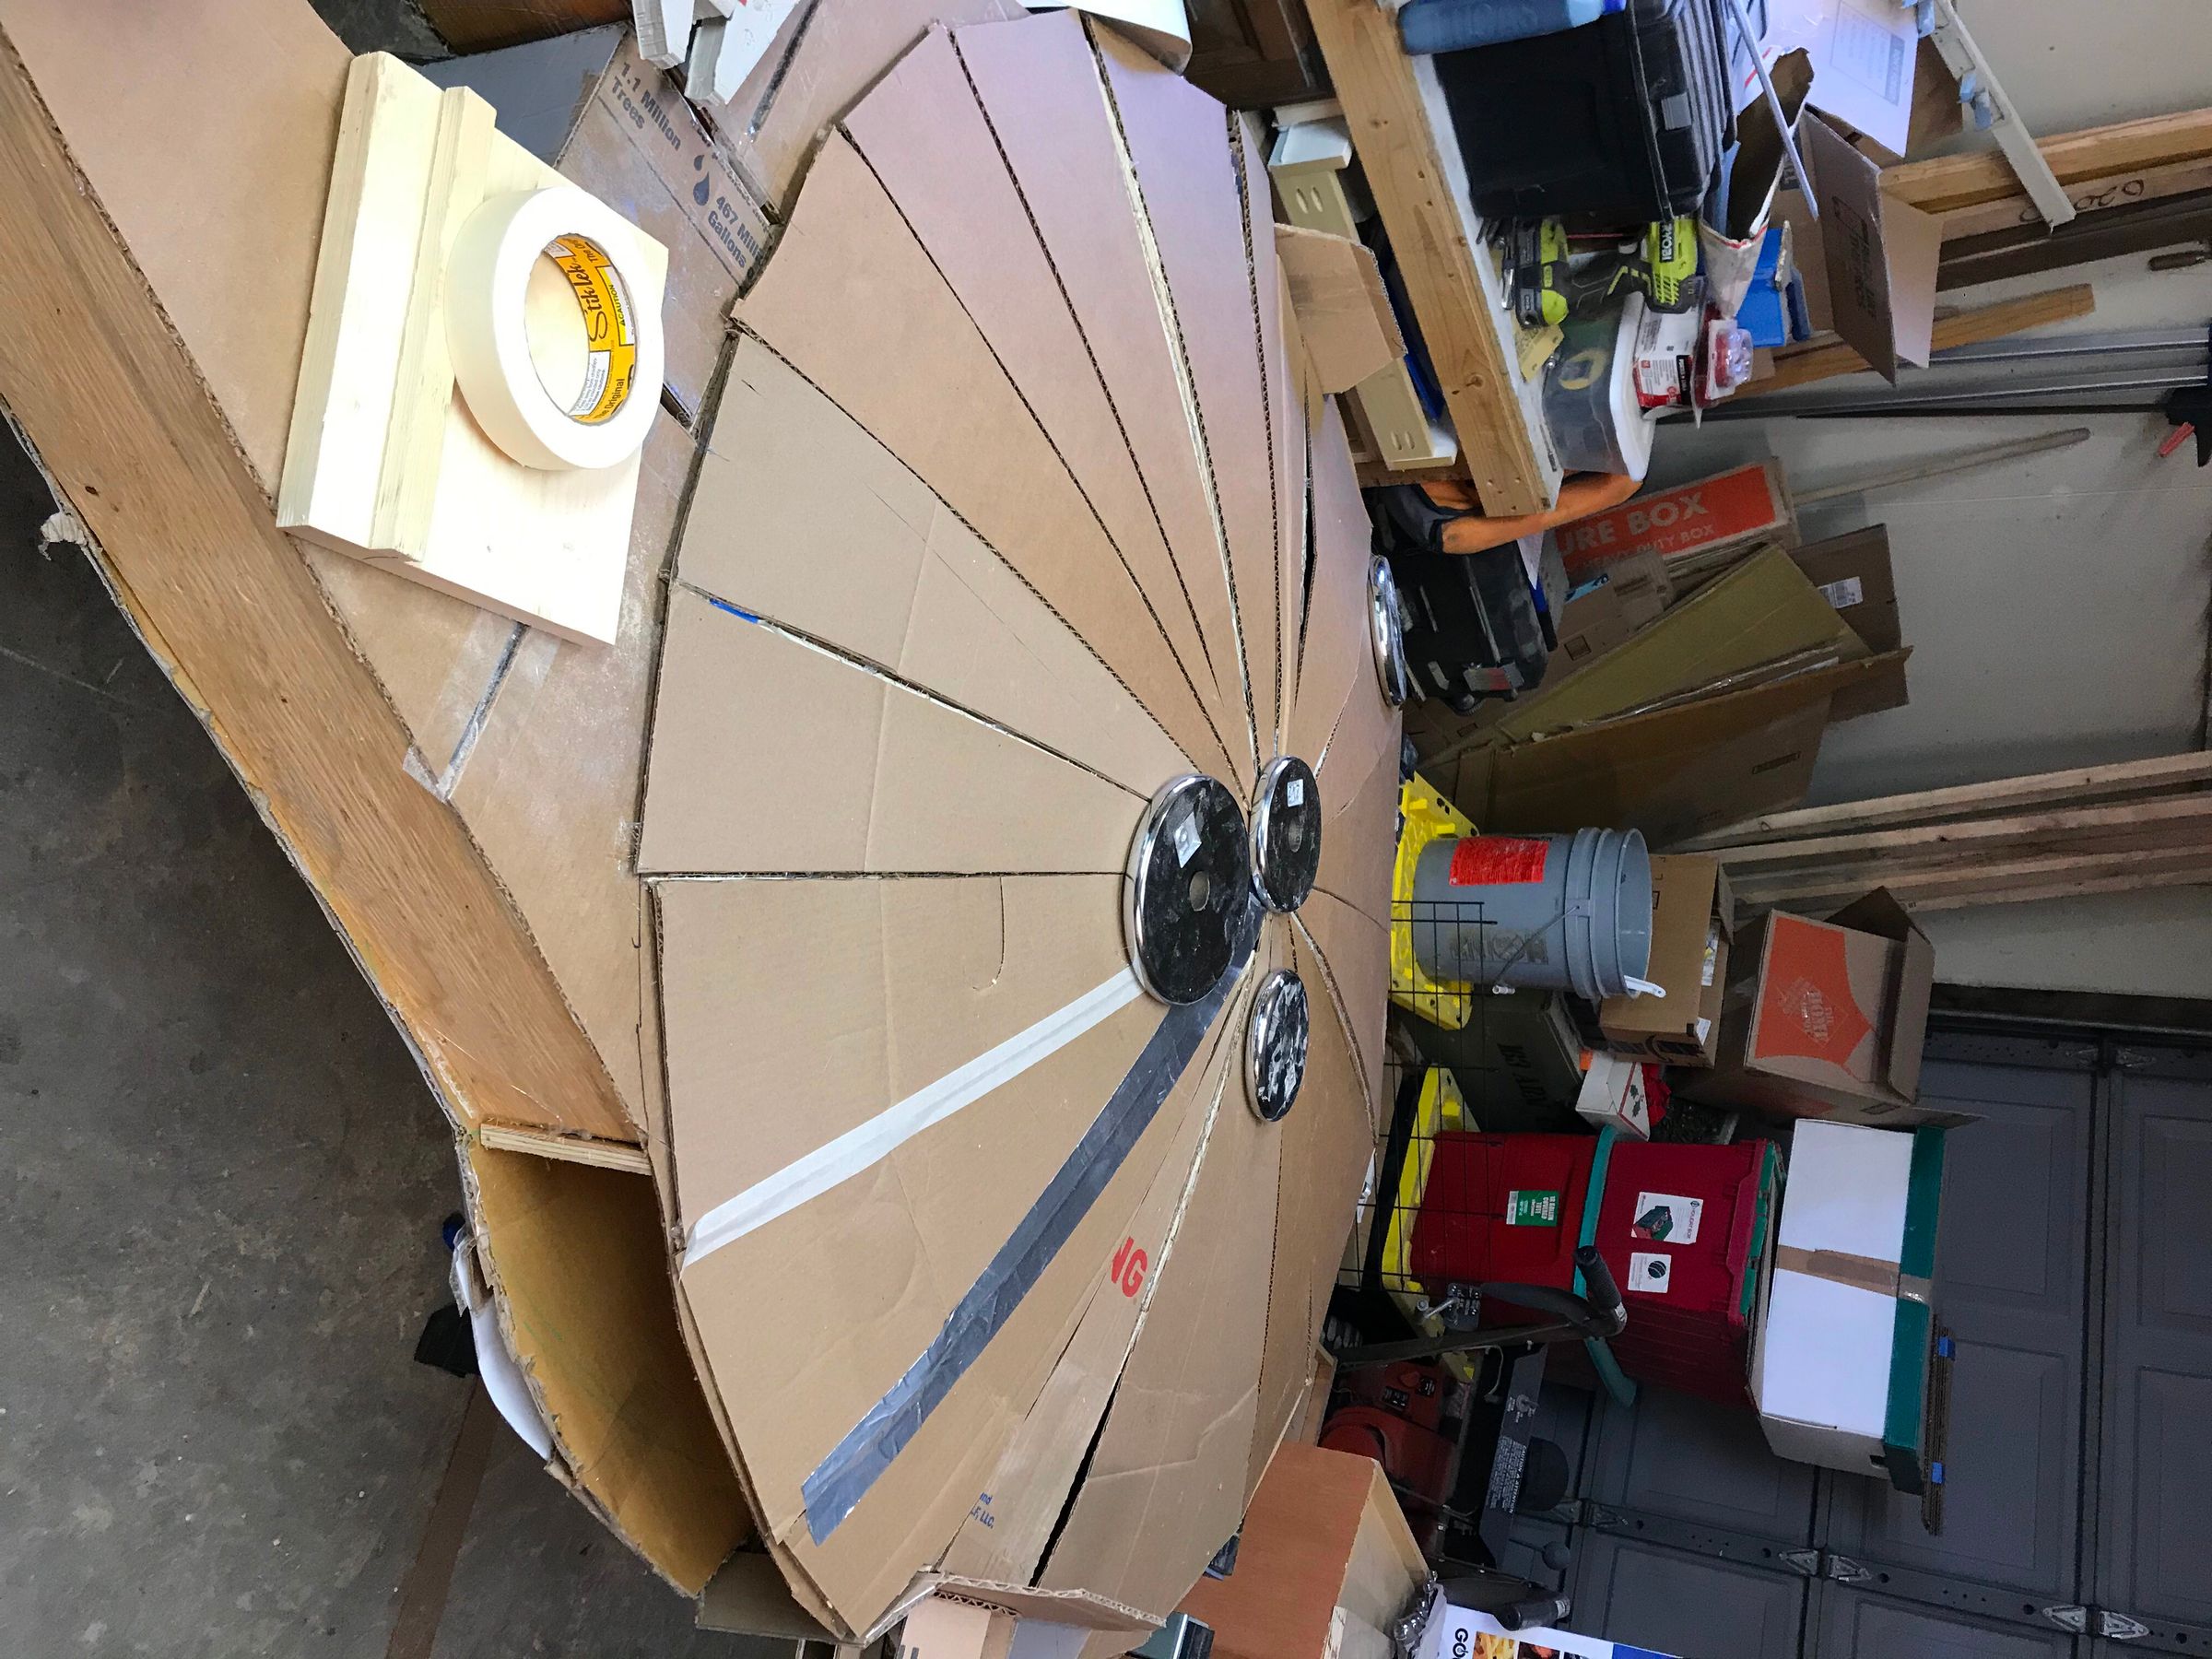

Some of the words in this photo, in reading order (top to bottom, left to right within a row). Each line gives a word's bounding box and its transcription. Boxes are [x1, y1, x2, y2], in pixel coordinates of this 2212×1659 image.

[612, 76, 645, 129] Trees
[621, 62, 641, 92] 1.1
[641, 89, 681, 151] Million
[716, 196, 738, 225] 467
[708, 210, 747, 268] Gallons
[1661, 221, 1673, 261] RYOBI
[608, 284, 625, 320] CAUTION
[605, 378, 626, 410] Original
[1627, 492, 1709, 535] BOX
[1680, 524, 1714, 544] BOX
[1518, 1445, 1527, 1472] CAUTION
[1509, 1480, 1520, 1514] ATTENTION
